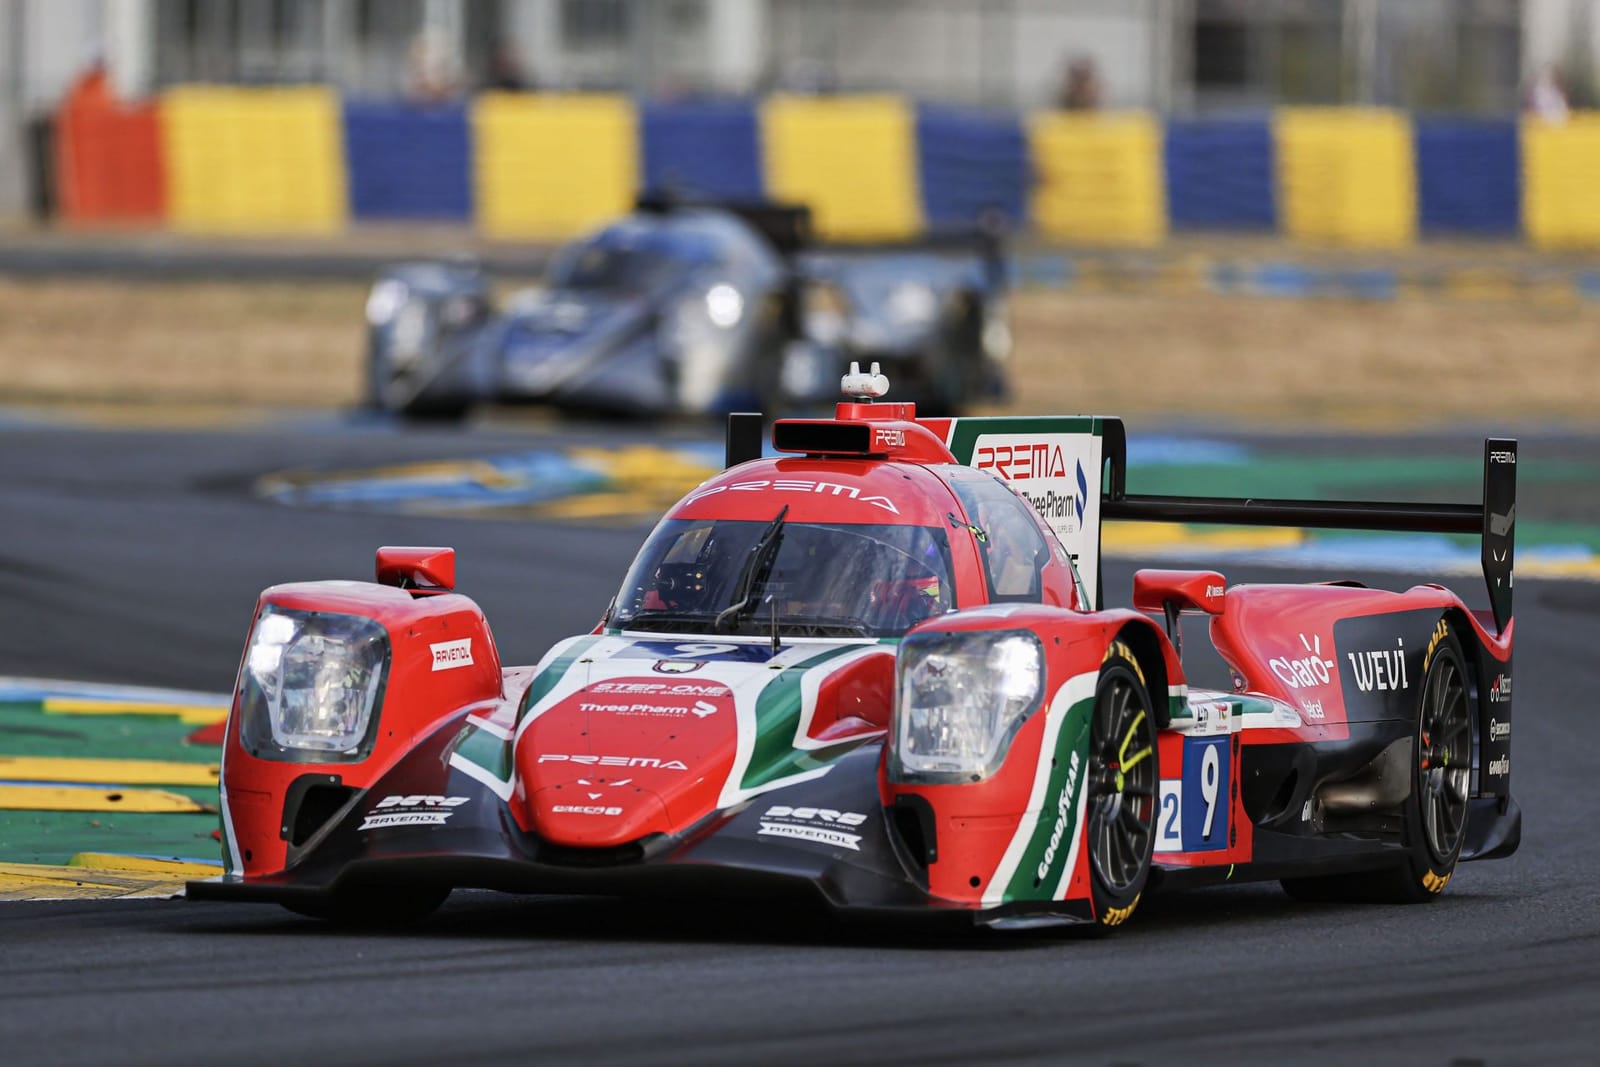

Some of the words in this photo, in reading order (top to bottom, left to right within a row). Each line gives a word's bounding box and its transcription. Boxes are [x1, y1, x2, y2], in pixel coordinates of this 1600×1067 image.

[875, 429, 906, 447] PREMA
[977, 443, 1067, 481] PREMA
[1490, 451, 1517, 464] PREMA
[685, 479, 901, 515] PREMA
[537, 754, 689, 770] PREMA
[1201, 743, 1220, 841] 9
[368, 815, 441, 826] RAVENOL
[1037, 749, 1080, 881] GOODYEAR
[1159, 791, 1180, 840] 2
[768, 826, 851, 845] RAVENOL
